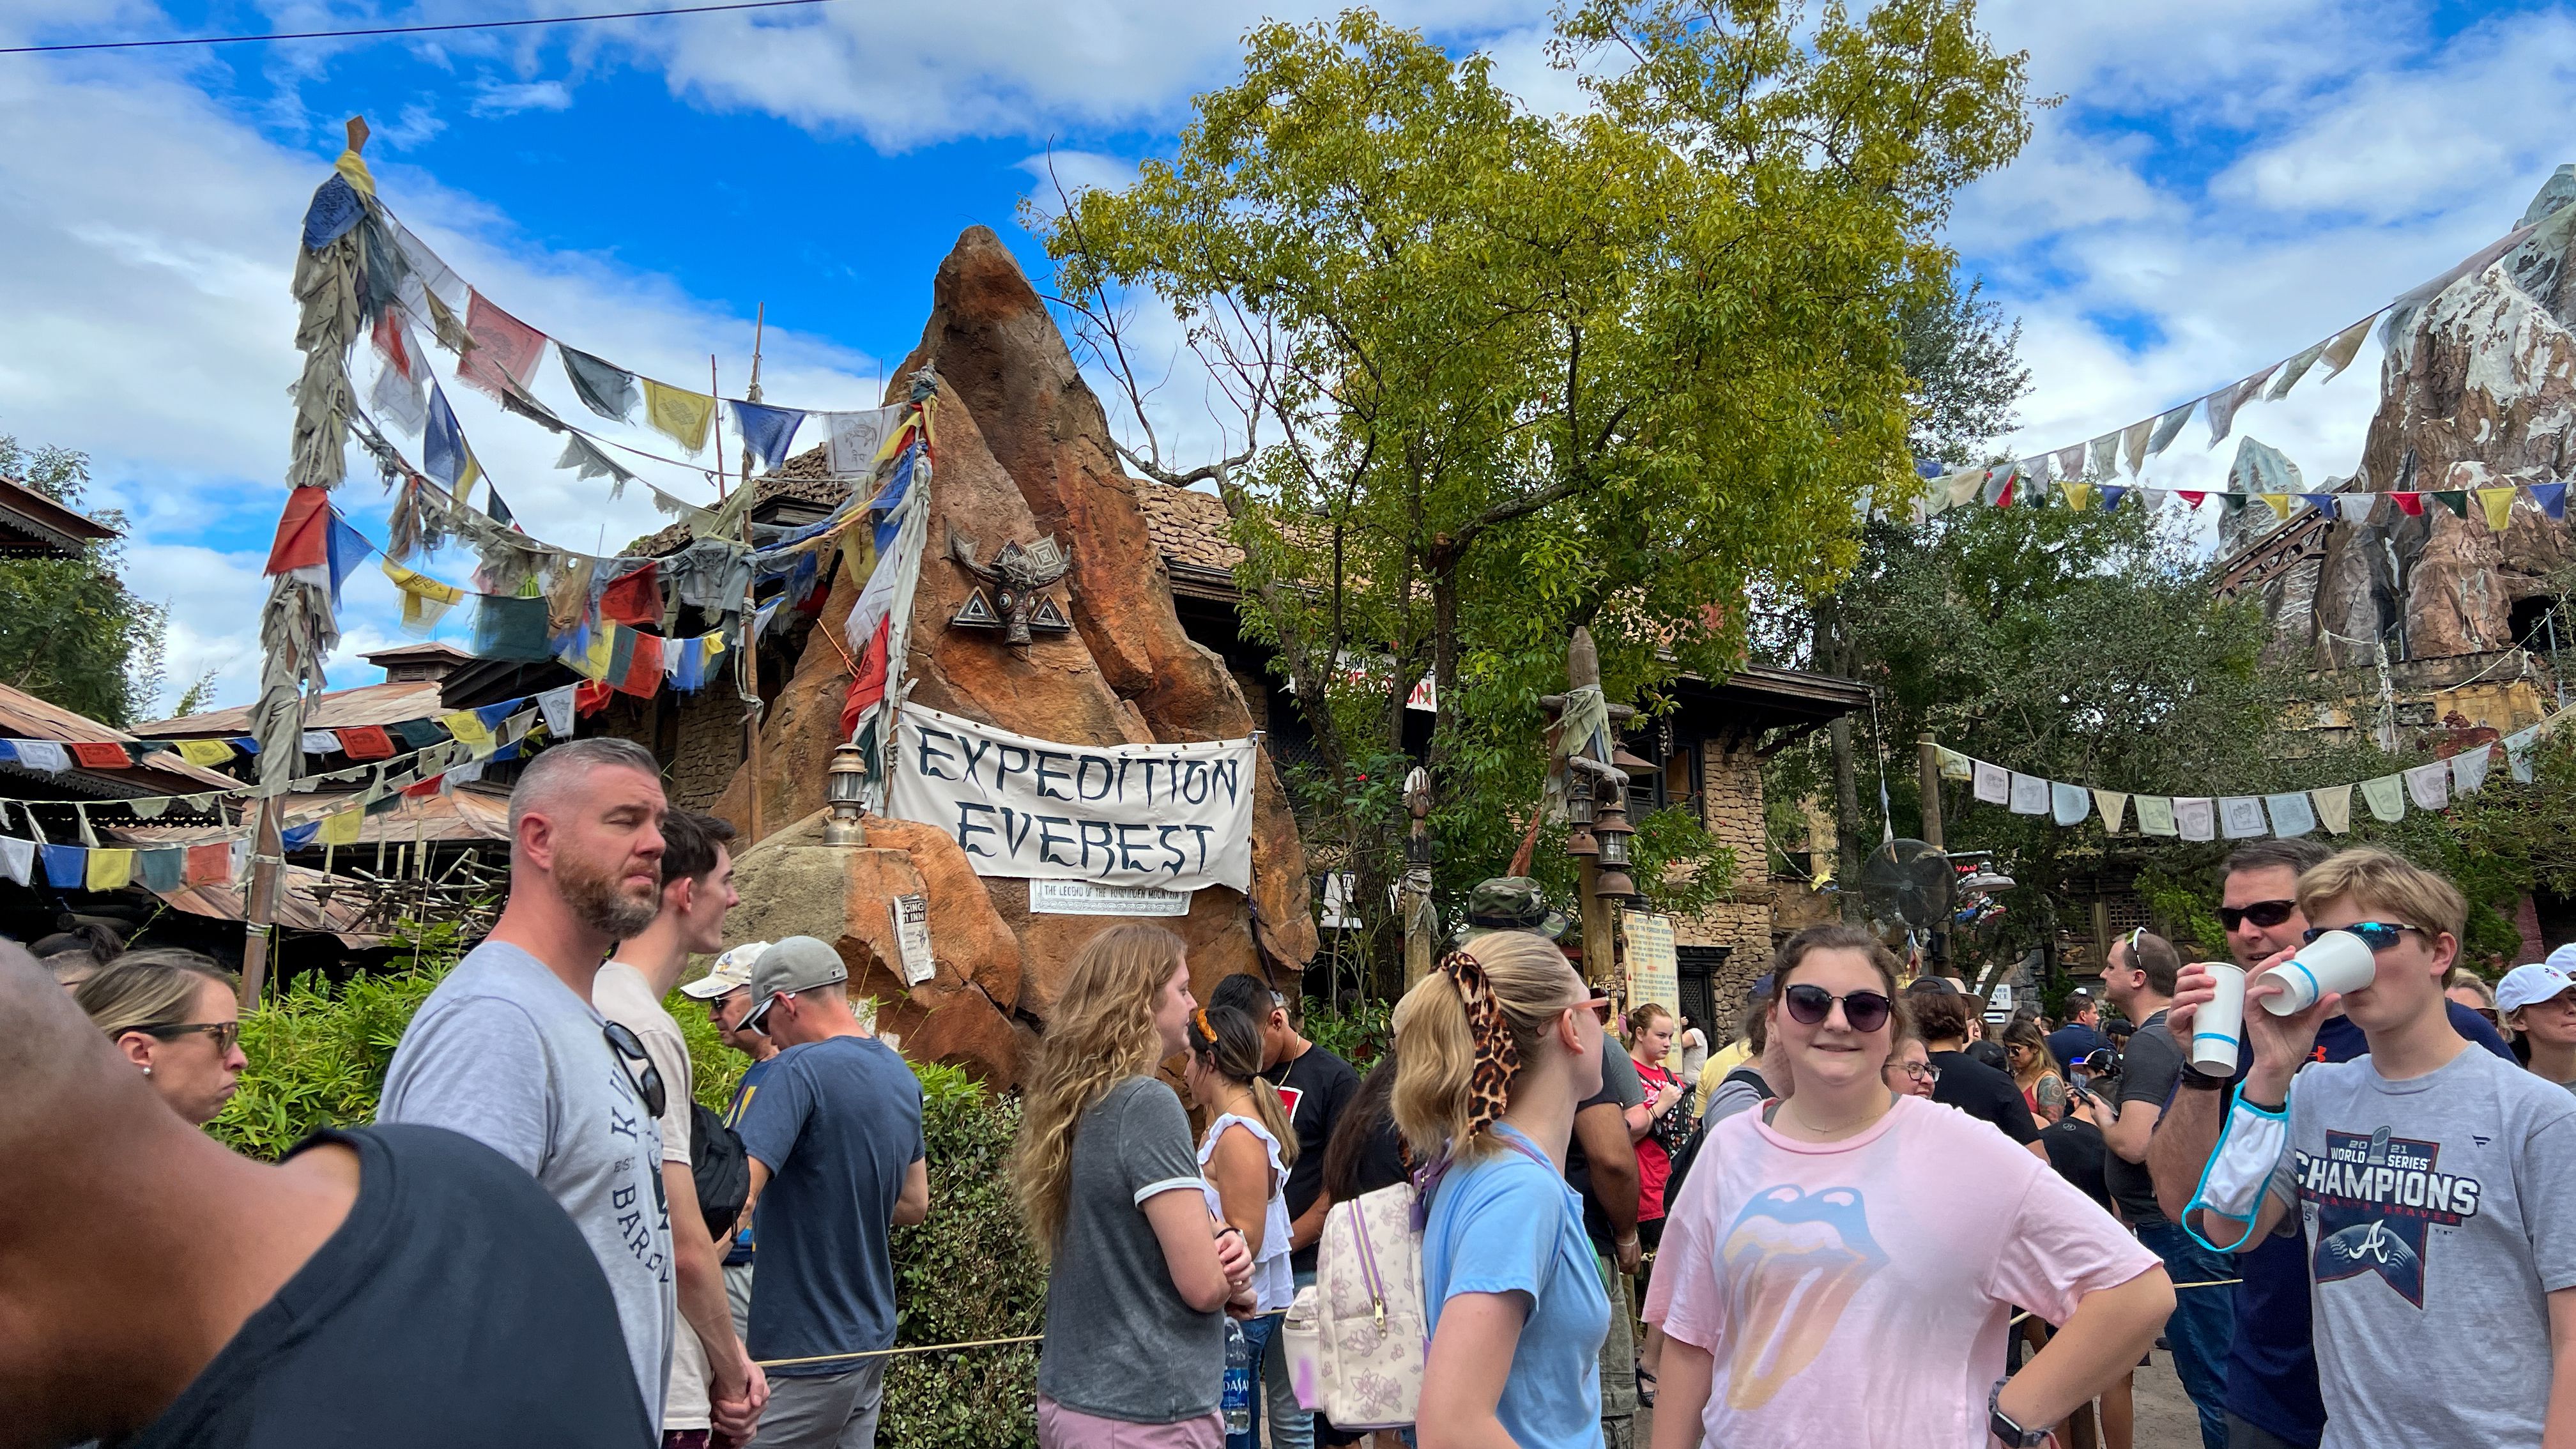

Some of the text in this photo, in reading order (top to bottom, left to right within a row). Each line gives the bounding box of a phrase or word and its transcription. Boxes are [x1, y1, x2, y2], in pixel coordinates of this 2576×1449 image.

[915, 724, 1238, 810] EXPEDITION
[954, 801, 1215, 879] EVEREST
[1045, 885, 1056, 896] THE
[1059, 886, 1083, 897] LEGEND
[1095, 887, 1107, 898] THE
[903, 902, 924, 914] CING
[910, 912, 924, 922] INN
[2349, 1139, 2407, 1154] 20 21
[2331, 1147, 2428, 1171] WORLD SERIES
